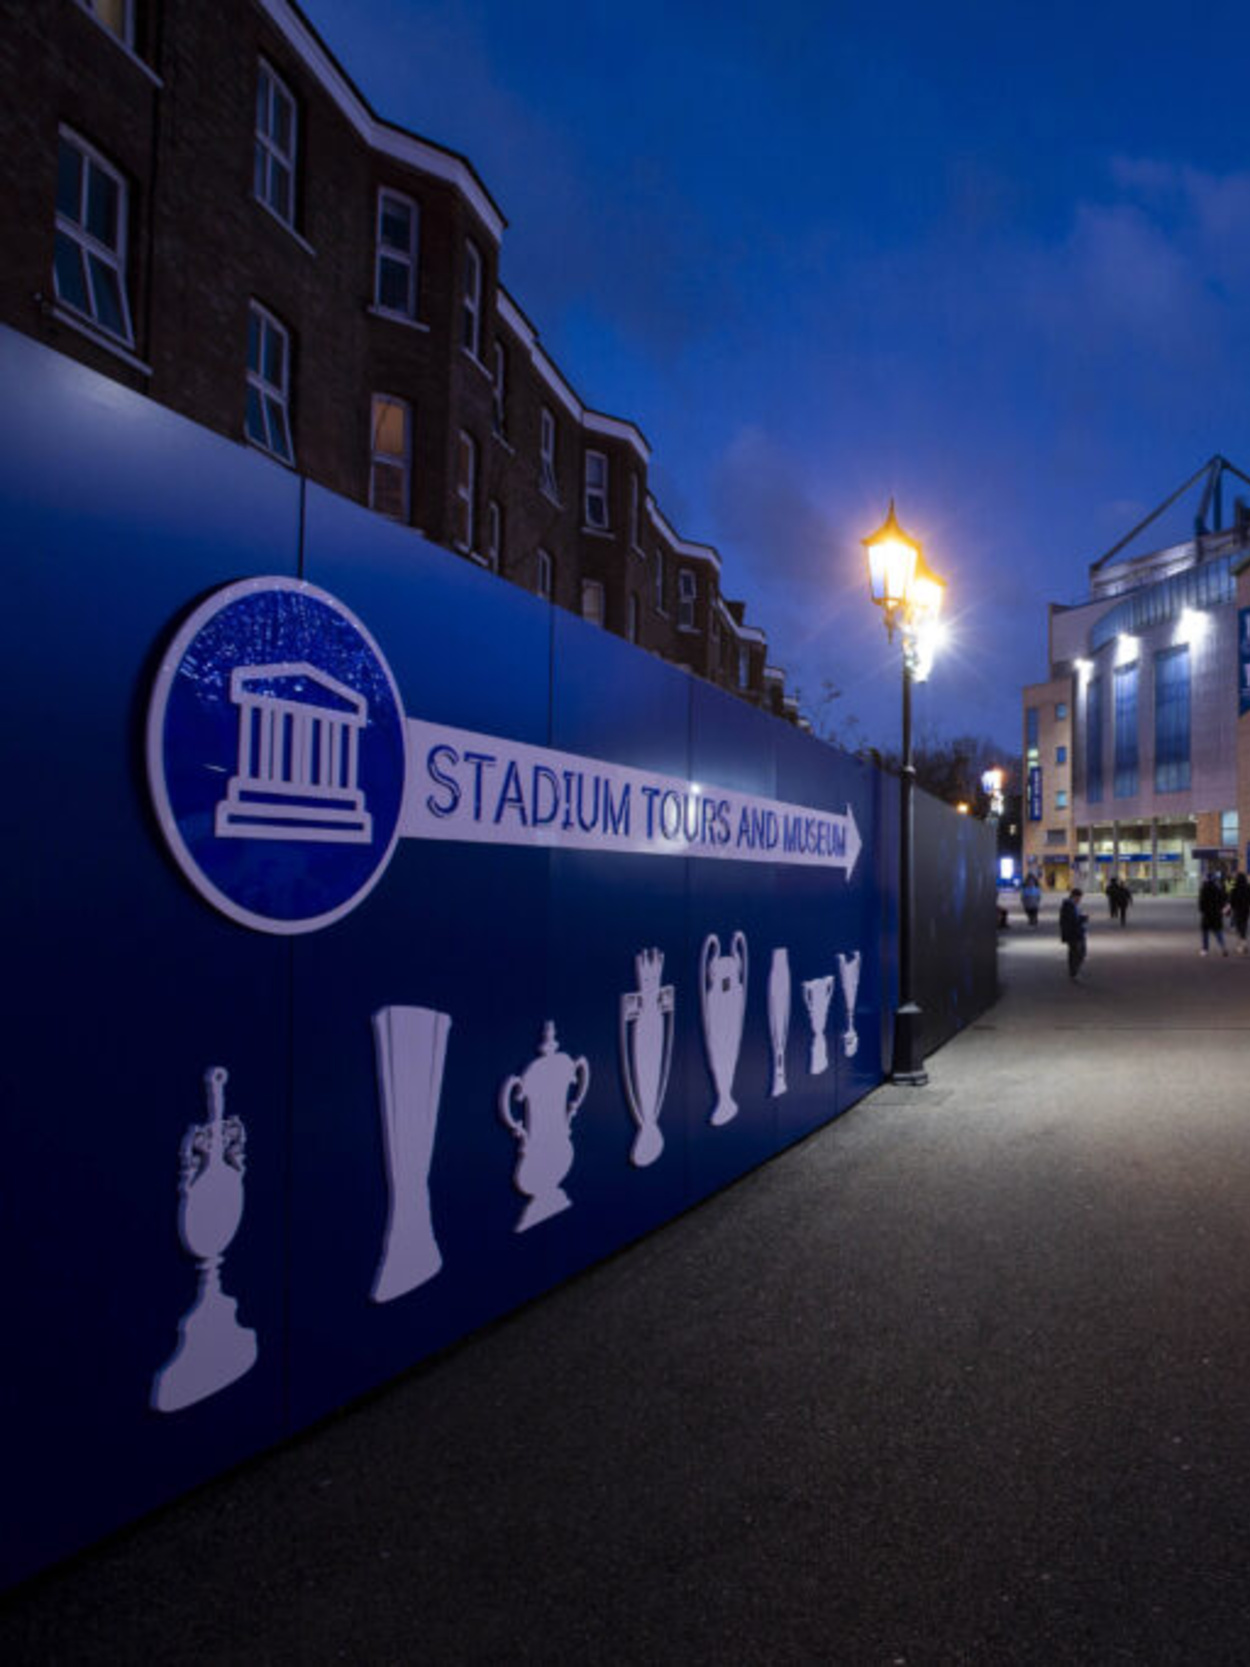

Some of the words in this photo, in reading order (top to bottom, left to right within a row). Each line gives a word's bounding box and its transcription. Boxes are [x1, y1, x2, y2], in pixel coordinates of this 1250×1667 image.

[426, 744, 631, 836] STADIUM
[641, 785, 732, 845] TOURS
[736, 806, 778, 850] AND
[783, 814, 846, 857] MUSEUM
